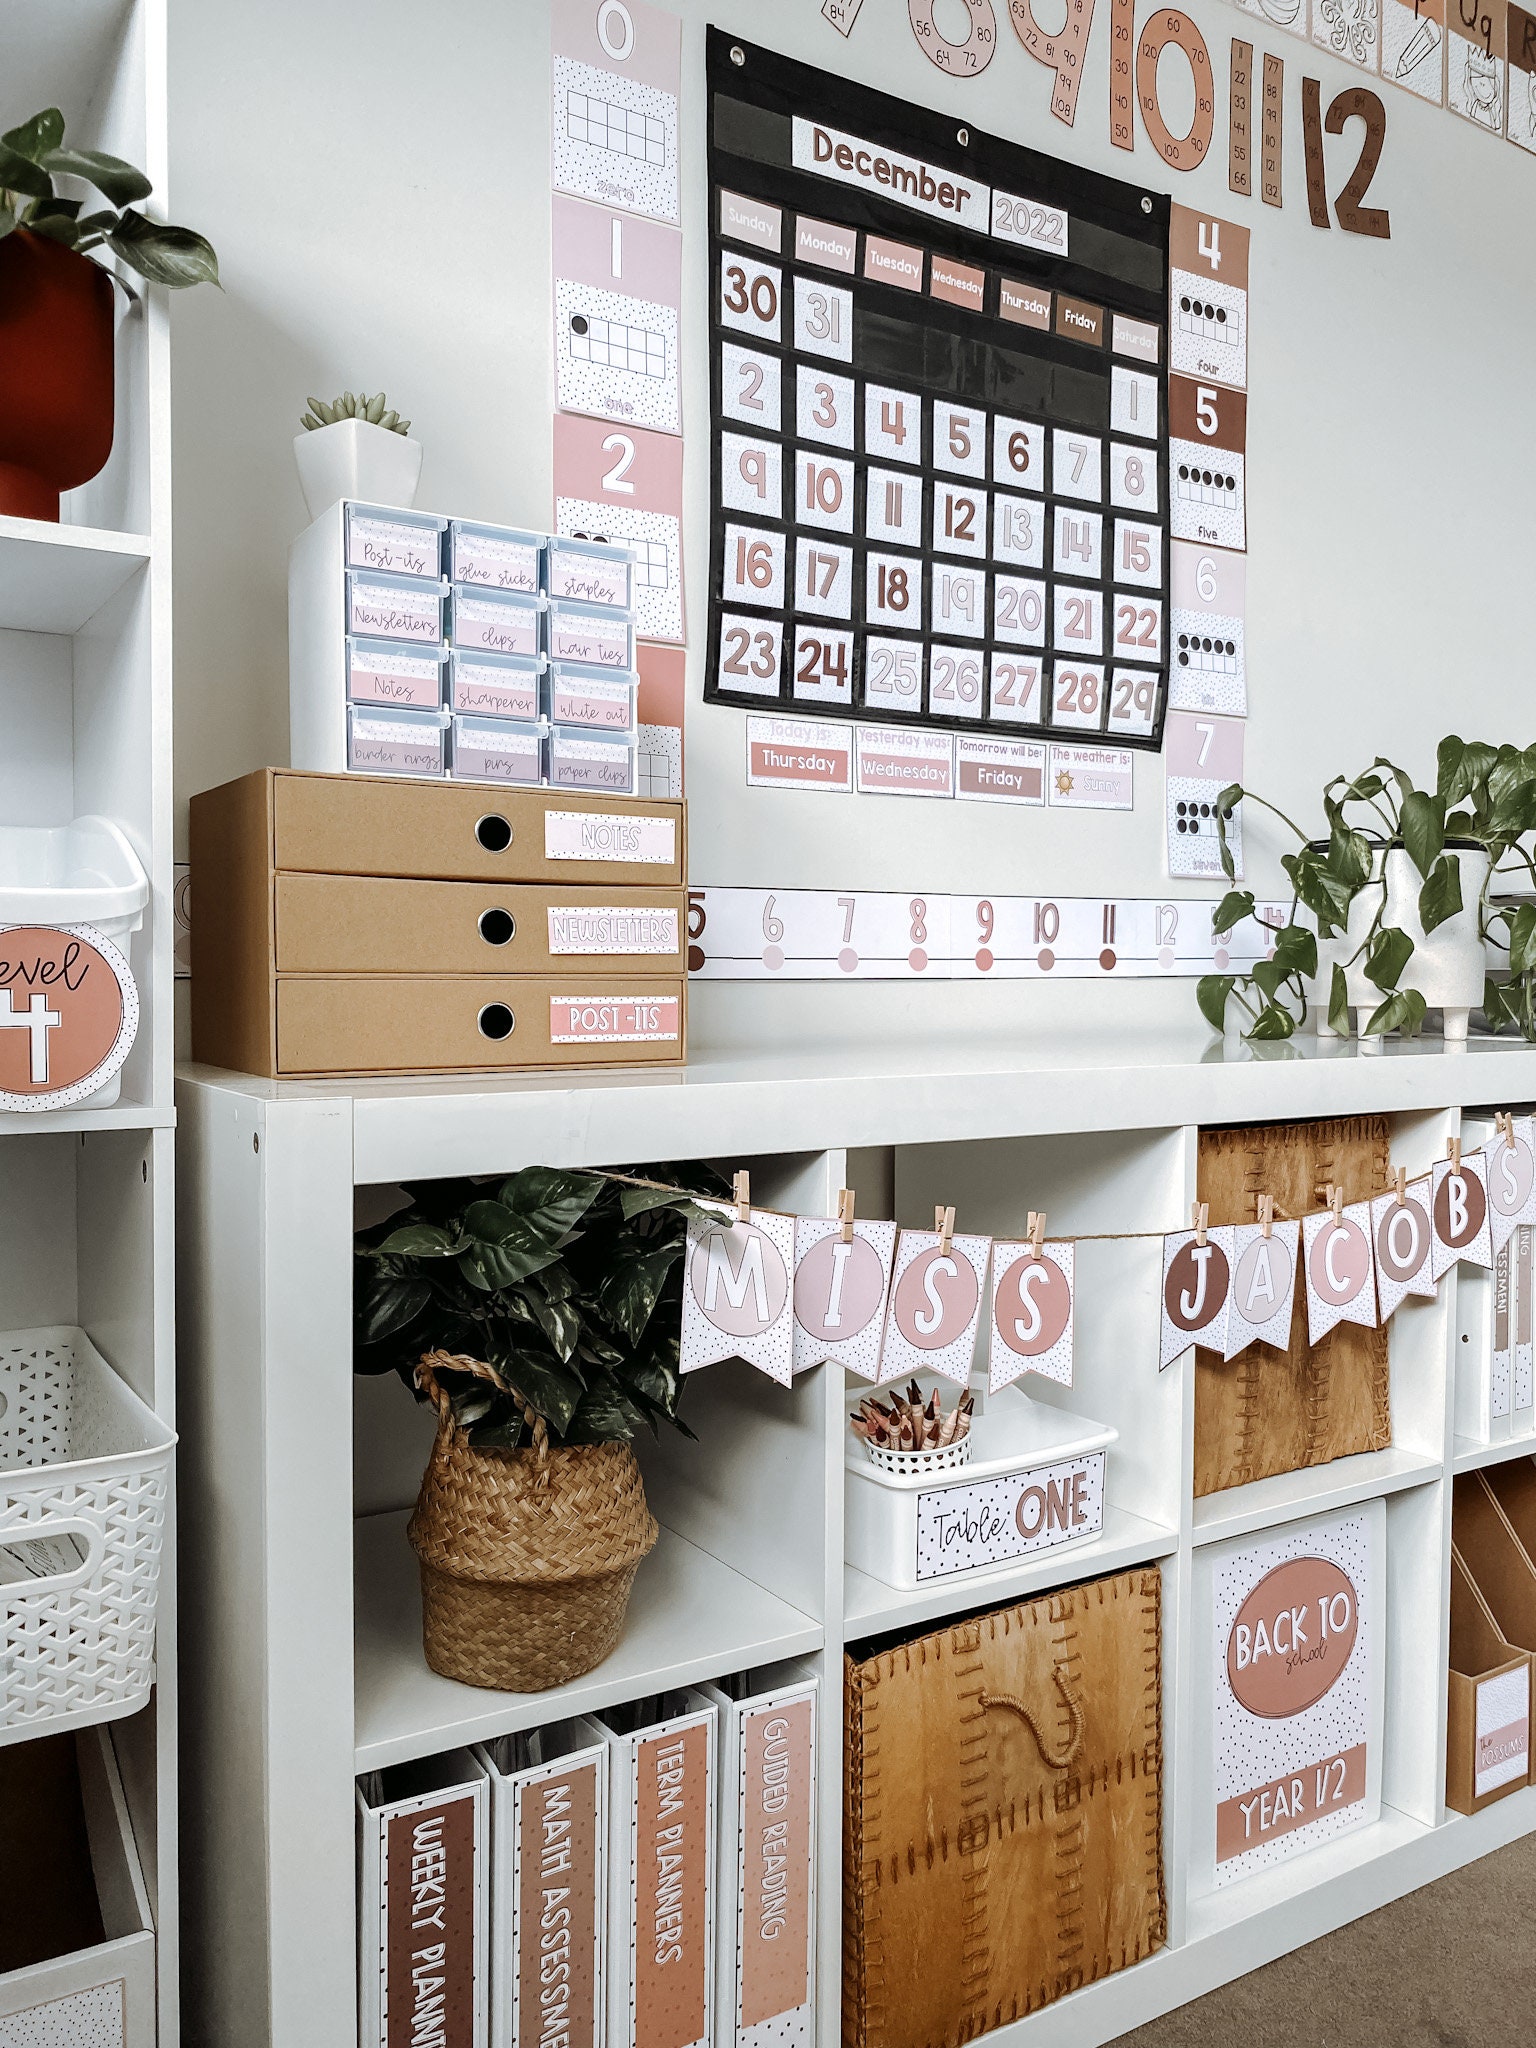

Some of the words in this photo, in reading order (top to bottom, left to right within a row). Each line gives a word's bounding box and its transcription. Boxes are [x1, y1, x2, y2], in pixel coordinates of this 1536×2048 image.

[830, 4, 845, 22] 84
[1012, 1, 1025, 18] 63
[597, 0, 635, 61] 0
[916, 20, 931, 36] 56
[977, 27, 991, 42] 80
[1073, 25, 1080, 38] 9
[1115, 25, 1128, 41] 20
[1167, 17, 1180, 33] 60
[1026, 28, 1038, 47] 72
[936, 50, 950, 65] 64
[963, 51, 977, 67] 72
[1046, 43, 1055, 58] 81
[1063, 49, 1077, 66] 90
[1142, 43, 1157, 60] 120
[1191, 48, 1205, 63] 70
[1115, 59, 1128, 74] 30
[1234, 70, 1246, 85] 22
[1267, 59, 1279, 74] 77
[1060, 74, 1072, 91] 99
[1266, 83, 1277, 98] 88
[1055, 96, 1071, 117] 108
[1115, 93, 1128, 109] 40
[1199, 98, 1212, 113] 80
[1234, 94, 1246, 109] 33
[1265, 108, 1277, 123] 99
[1115, 124, 1128, 139] 50
[1265, 134, 1276, 148] 110
[1164, 143, 1180, 159] 100
[1190, 137, 1203, 151] 90
[1234, 145, 1246, 160] 55
[1302, 76, 1391, 240] 12
[812, 127, 971, 213] December
[995, 198, 1064, 246] 2022
[1234, 171, 1247, 186] 66
[1265, 182, 1278, 198] 132
[597, 179, 636, 203] zero
[1198, 220, 1221, 271] 4
[728, 207, 774, 237] Sunday
[800, 231, 852, 261] Monday
[870, 249, 920, 280] Tuesday
[931, 268, 984, 298] Wednesday
[1001, 291, 1050, 319] Thursday
[1065, 309, 1097, 333] Friday
[1113, 326, 1158, 352] Saturday
[723, 265, 777, 323] 30
[804, 291, 840, 344] 31
[1197, 359, 1220, 375] four
[1130, 380, 1138, 421] 1
[1196, 386, 1219, 437] 5
[739, 361, 764, 411] 2
[812, 382, 837, 428] 3
[881, 401, 907, 445] 4
[949, 414, 971, 459] 5
[1008, 430, 1030, 473] 6
[1068, 442, 1088, 483] 7
[1124, 456, 1145, 497] 8
[601, 432, 637, 495] 2
[739, 449, 766, 498] 9
[807, 462, 843, 514] 10
[885, 480, 902, 528] 11
[944, 493, 976, 542] 12
[1003, 504, 1033, 551] 13
[1062, 517, 1092, 562] 14
[1123, 529, 1151, 573] 15
[1197, 526, 1219, 541] five
[458, 565, 490, 582] glue
[499, 571, 536, 591] sticks
[564, 577, 616, 602] staples
[1195, 556, 1218, 603] 6
[736, 536, 773, 588] 16
[807, 549, 840, 599] 17
[877, 563, 909, 611] 18
[941, 574, 975, 622] 19
[996, 586, 1042, 631] 20
[1063, 597, 1092, 640] 21
[1116, 605, 1158, 648] 22
[355, 606, 438, 636] Newsletters
[482, 626, 517, 651] clips
[558, 636, 591, 658] hair
[597, 643, 624, 666] ties
[723, 627, 776, 679] 23
[797, 638, 848, 687] 24
[870, 649, 918, 695] 25
[933, 656, 980, 703] 26
[994, 664, 1037, 707] 27
[1056, 670, 1099, 714] 28
[1112, 679, 1155, 721] 29
[373, 675, 416, 702] Notes
[459, 687, 535, 712] sharpener
[560, 702, 600, 719] white
[605, 706, 628, 725] out
[769, 720, 812, 740] Today
[858, 728, 921, 749] Yesterday
[924, 734, 951, 749] was:
[959, 739, 1008, 754] Tomorrow
[1010, 745, 1026, 756] will
[1027, 746, 1042, 759] be:
[1052, 747, 1070, 761] The
[1073, 750, 1117, 764] weather
[1119, 753, 1131, 765] is:
[1194, 722, 1215, 769] 7
[355, 746, 396, 763] binder
[403, 753, 440, 771] rings
[484, 757, 514, 774] pins
[762, 749, 836, 775] Thursday
[557, 765, 592, 780] paper
[598, 763, 628, 785] clips
[862, 758, 947, 784] Wednesday
[977, 767, 1022, 789] Friday
[1083, 774, 1121, 795] Sunny
[581, 823, 642, 851] NOTES
[553, 917, 674, 943] NEWSLETTERS
[762, 894, 784, 942] 6
[837, 897, 856, 943] 7
[909, 898, 927, 944] 8
[976, 900, 994, 944] 9
[1033, 902, 1060, 944] 10
[1102, 904, 1117, 945] 11
[1155, 904, 1179, 946] 12
[570, 1006, 619, 1032] POST
[703, 1232, 1050, 1341] MISS
[1180, 1146, 1518, 1321] JACOBS
[933, 1506, 1007, 1549] Table
[1015, 1470, 1088, 1539] ONE
[1235, 1604, 1309, 1671] BACK
[1317, 1591, 1351, 1640] TO
[1286, 1636, 1328, 1676] school
[1481, 1735, 1525, 1767] POSSUMS
[761, 1717, 791, 1814] GUIDED
[655, 1738, 685, 1821] TERM
[1238, 1777, 1304, 1840] YEAR
[1314, 1758, 1347, 1809] 1/2
[540, 1784, 572, 1879] MATH
[411, 1815, 446, 1931] WEEKLY
[760, 1819, 790, 1941] READING
[654, 1821, 685, 1965] PLANNERS
